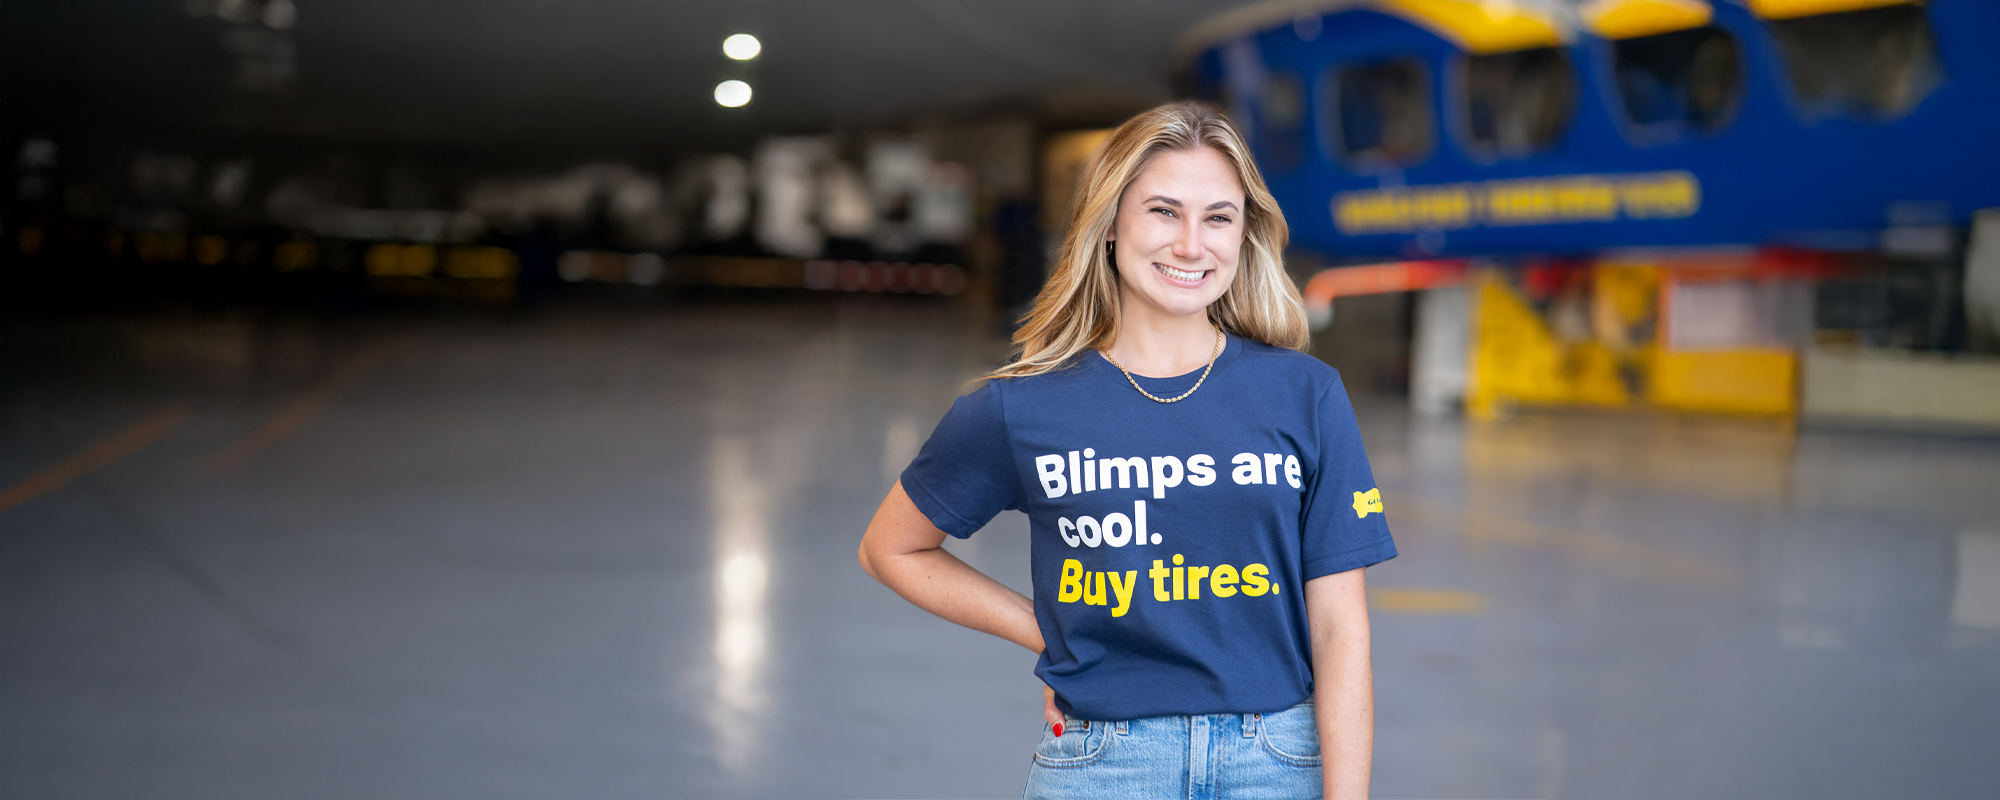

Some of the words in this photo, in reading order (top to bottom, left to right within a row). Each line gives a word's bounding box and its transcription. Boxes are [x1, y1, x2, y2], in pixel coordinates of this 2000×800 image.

[1035, 447, 1217, 499] Blimps
[1231, 452, 1301, 488] are
[1058, 500, 1163, 548] cool.
[1058, 558, 1137, 618] Buy
[1149, 553, 1280, 602] tires.
